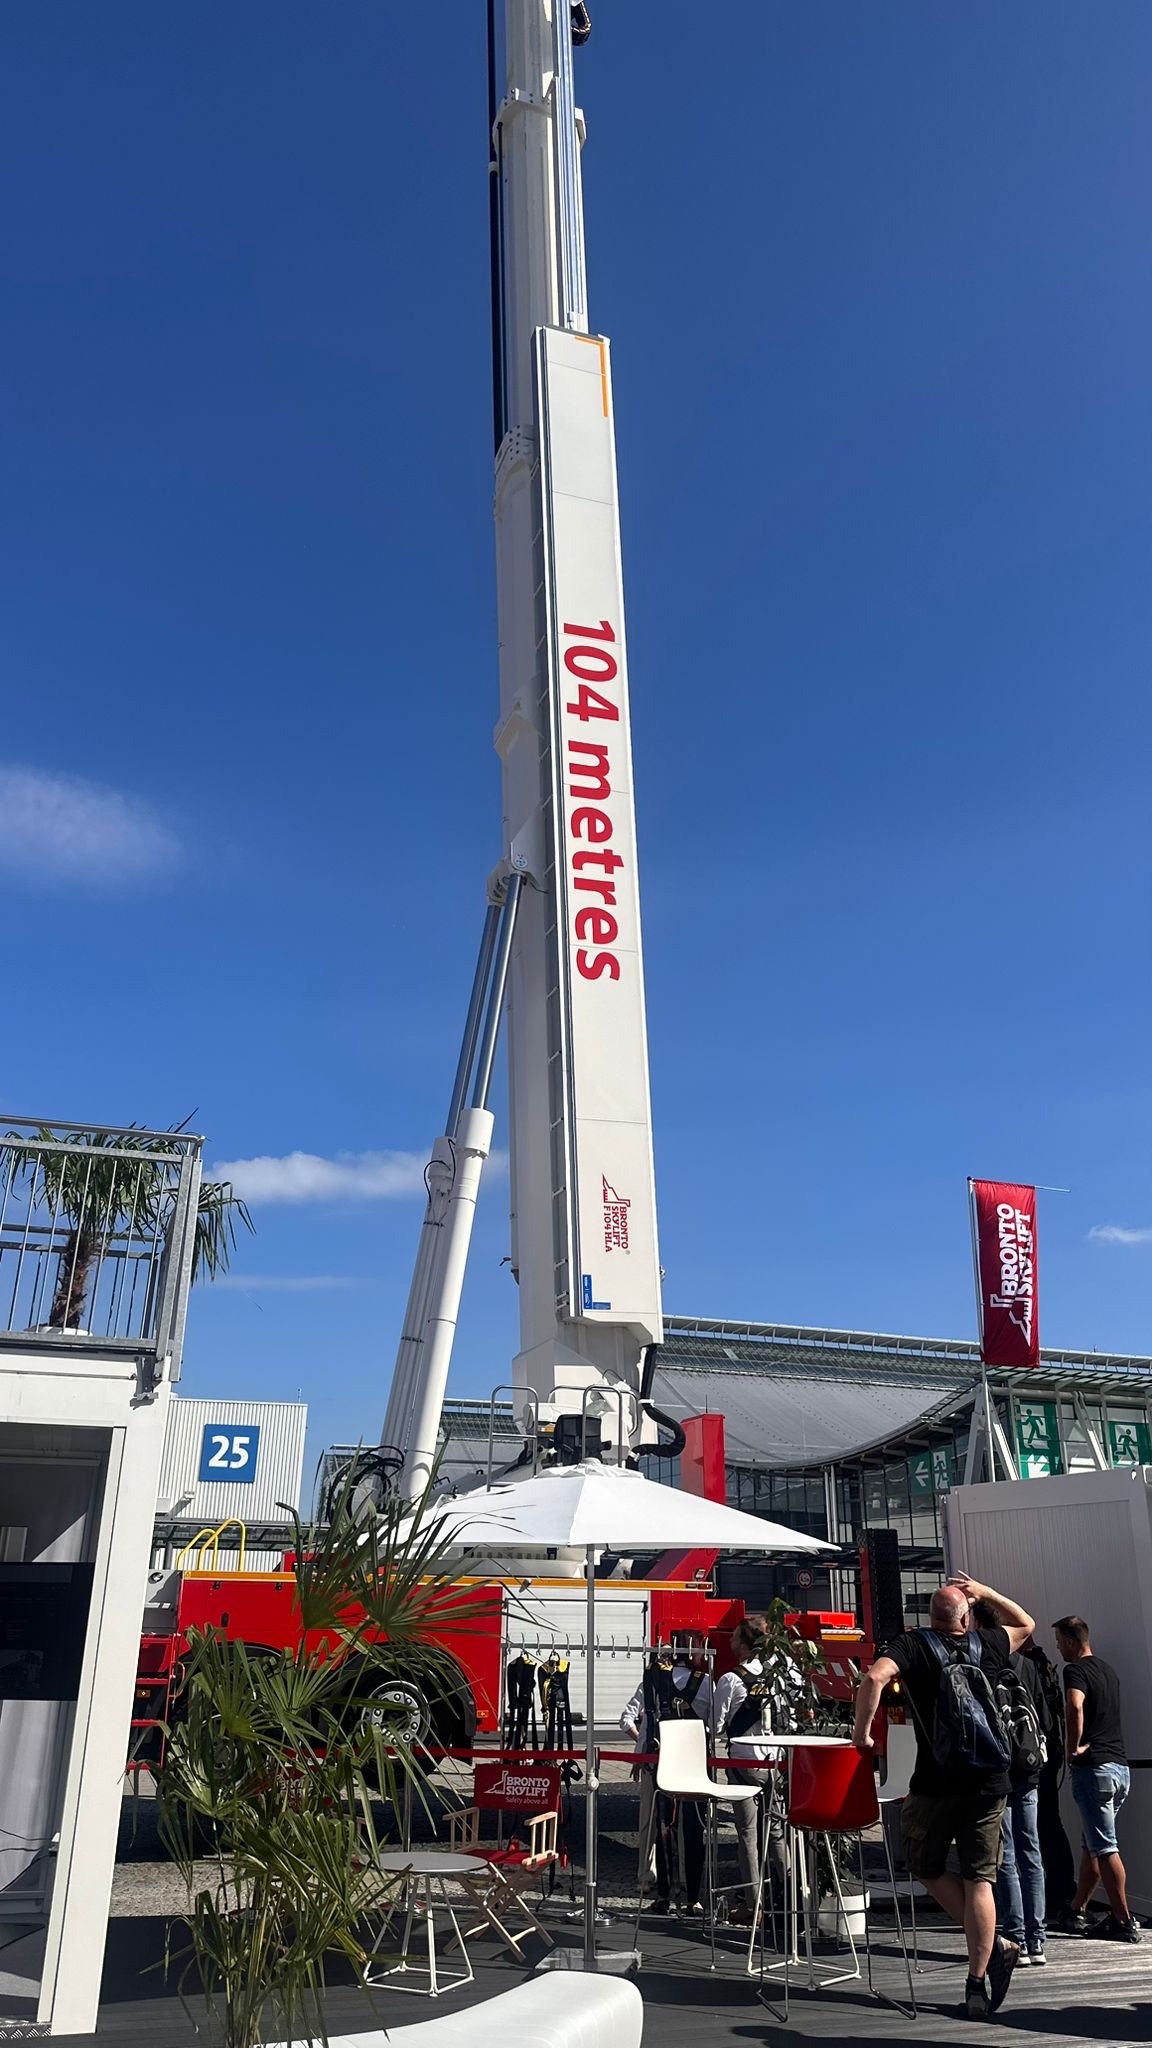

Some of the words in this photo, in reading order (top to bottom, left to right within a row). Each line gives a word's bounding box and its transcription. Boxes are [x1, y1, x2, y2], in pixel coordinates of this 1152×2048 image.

[564, 620, 620, 722] 104
[568, 740, 624, 980] metres
[612, 1206, 620, 1248] SKYLIFT
[620, 1206, 628, 1249] BRONTO
[996, 1203, 1019, 1296] BRONTO
[208, 1435, 250, 1469] 25
[505, 1796, 522, 1804] Safety
[506, 1776, 550, 1788] BRONTO
[506, 1786, 548, 1797] SKYLIFT
